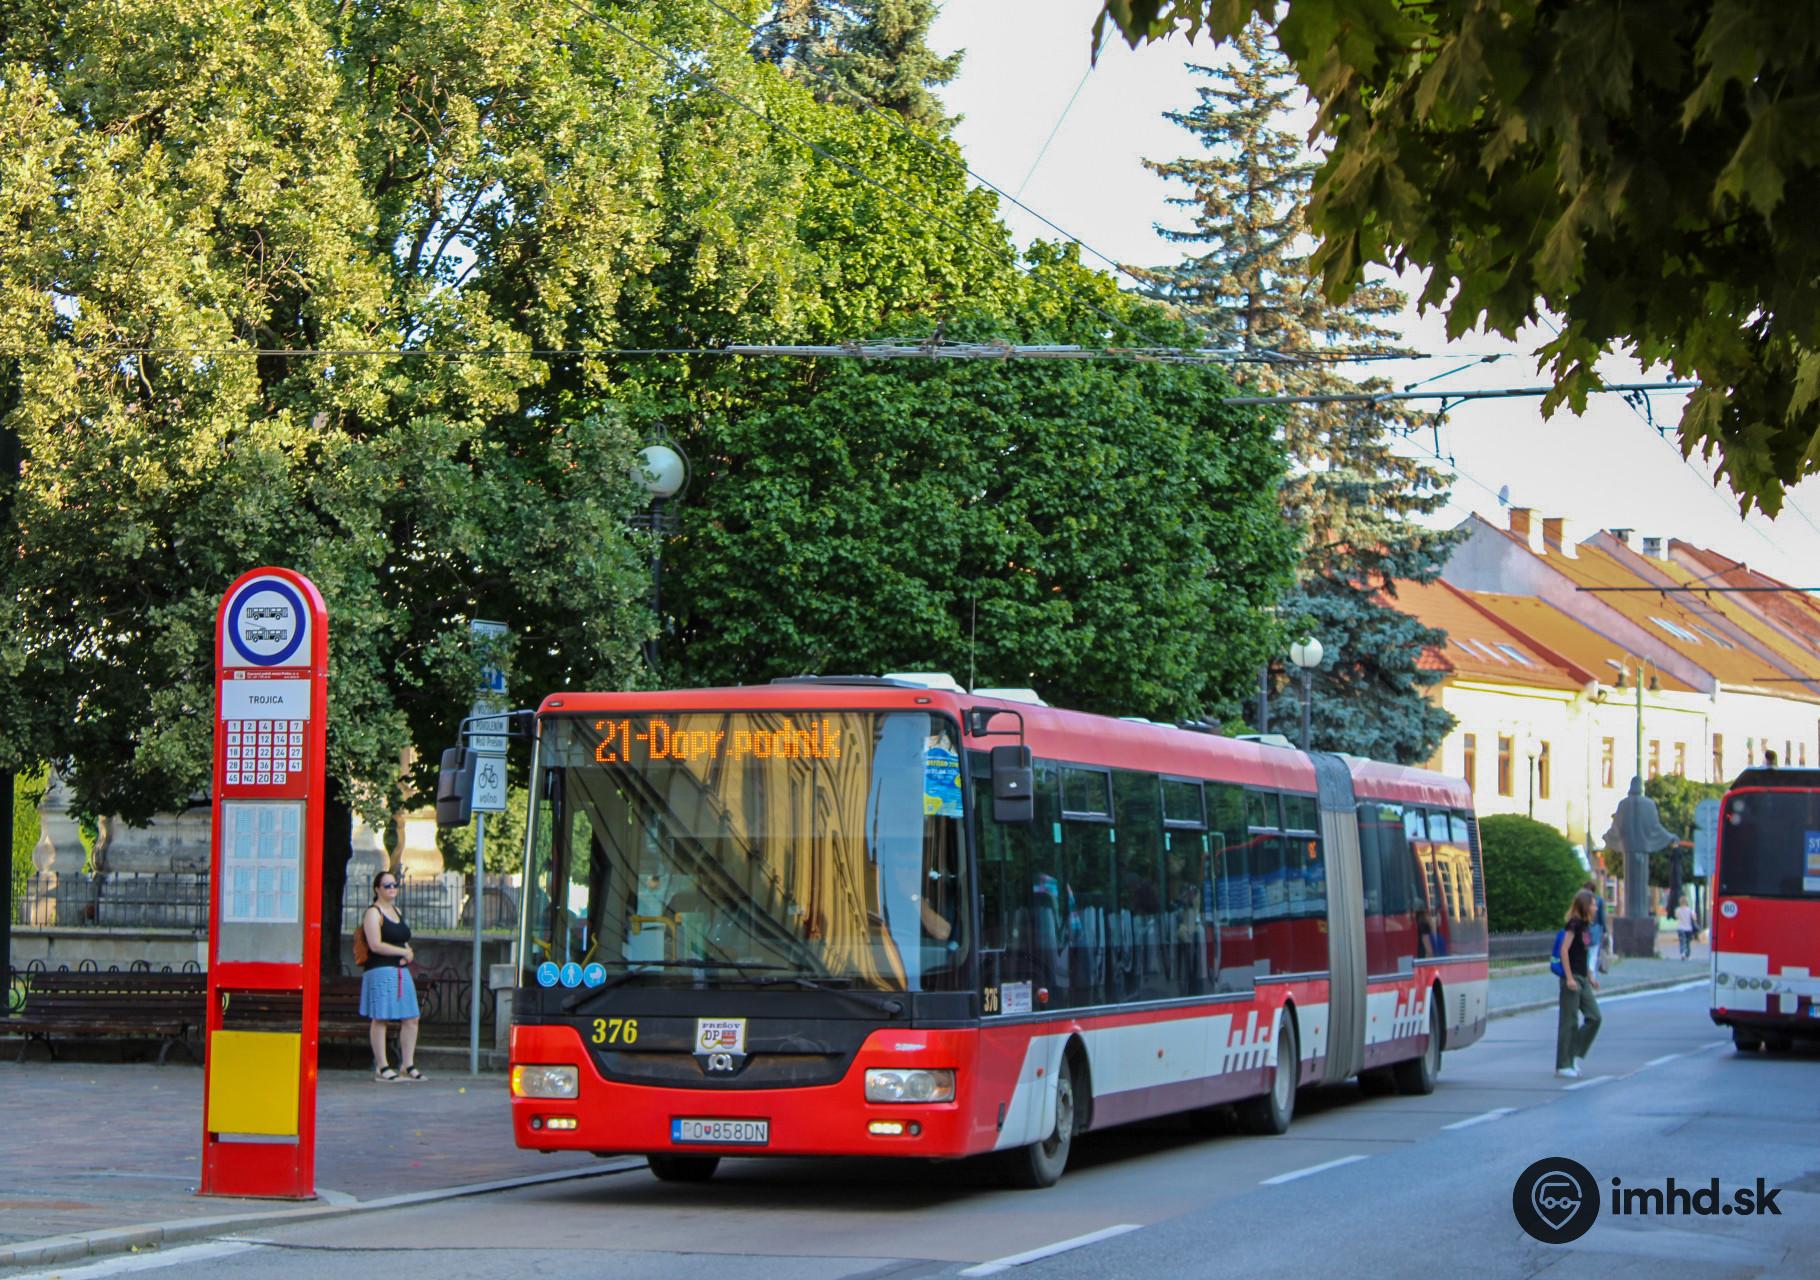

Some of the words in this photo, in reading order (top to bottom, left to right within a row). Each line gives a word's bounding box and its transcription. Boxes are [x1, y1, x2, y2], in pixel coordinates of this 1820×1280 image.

[248, 695, 284, 704] TROJICA
[230, 749, 238, 757] 18
[245, 749, 254, 757] 21
[260, 749, 270, 757] 22
[276, 749, 285, 757] 24
[291, 749, 301, 757] 27
[228, 774, 238, 783] 45
[244, 774, 253, 783] N2
[258, 774, 269, 783] 20
[274, 774, 285, 783] 23
[984, 987, 998, 1012] 376
[702, 1021, 741, 1029] PREŠOV
[592, 1018, 638, 1044] 376
[704, 1030, 720, 1041] DP
